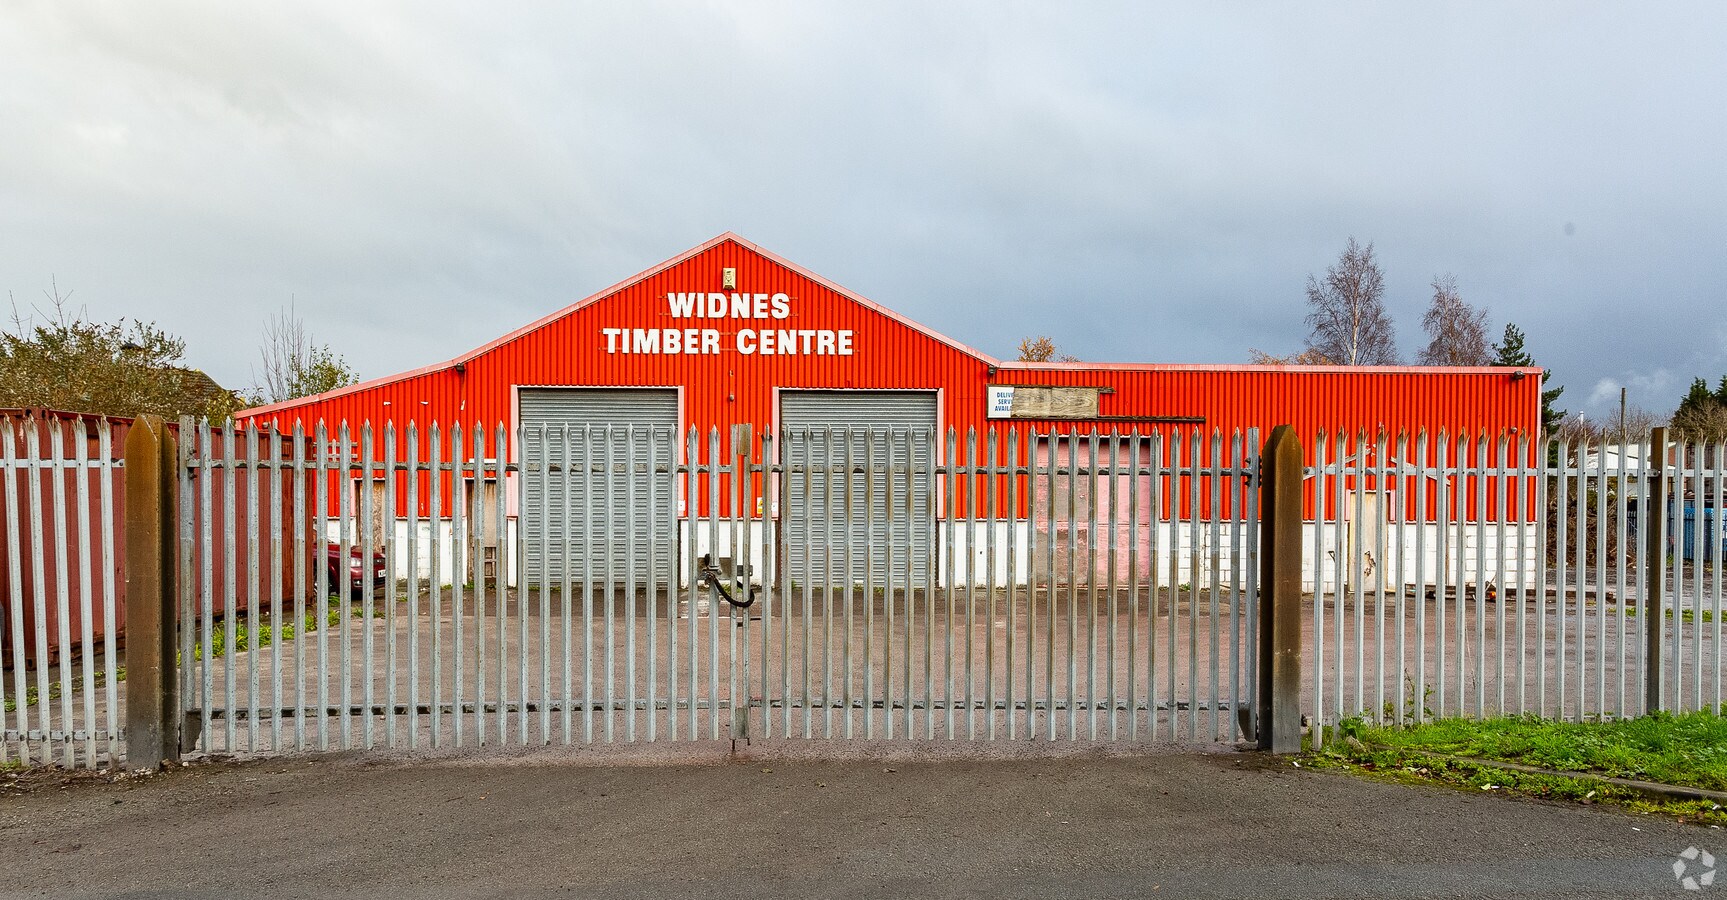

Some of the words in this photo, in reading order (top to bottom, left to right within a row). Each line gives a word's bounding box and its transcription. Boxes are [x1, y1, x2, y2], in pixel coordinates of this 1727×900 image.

[667, 292, 790, 319] WIDNES
[602, 328, 720, 354] TIMBER
[736, 329, 853, 355] CENTRE
